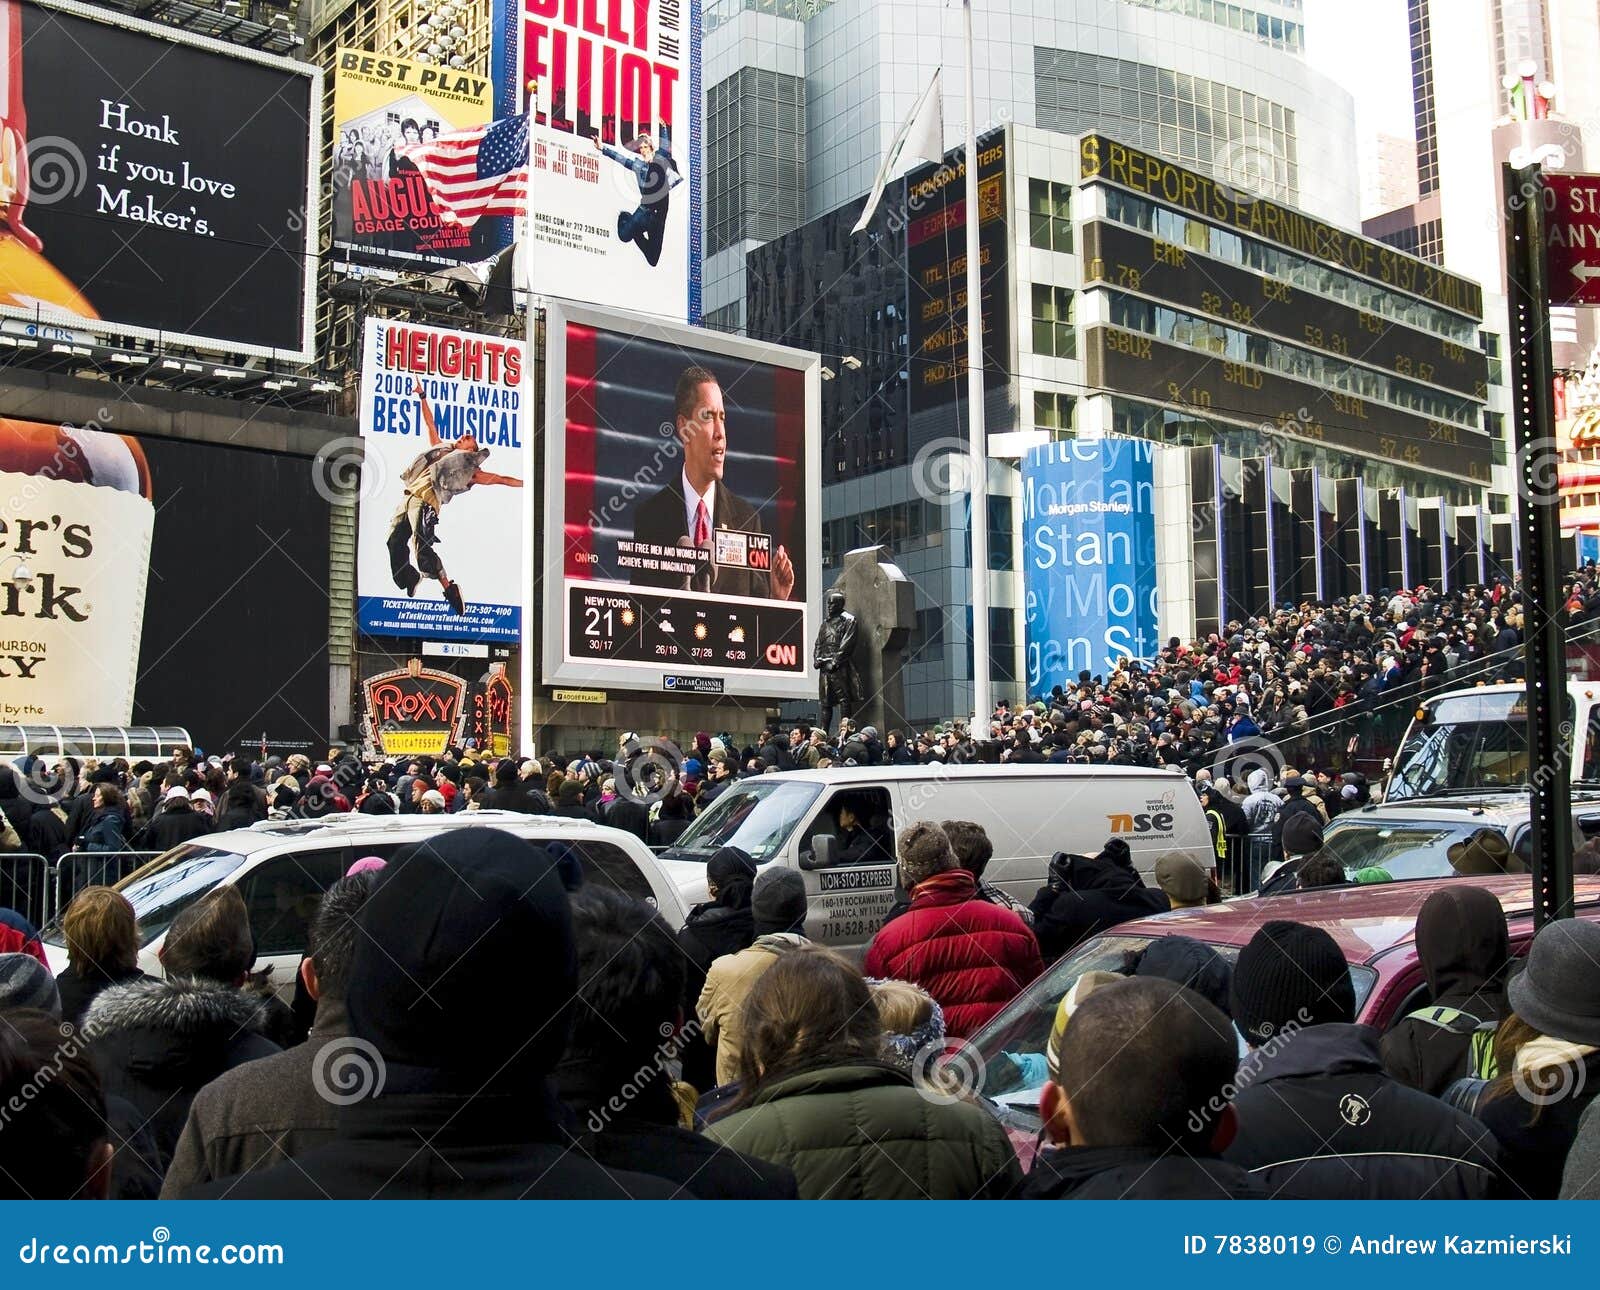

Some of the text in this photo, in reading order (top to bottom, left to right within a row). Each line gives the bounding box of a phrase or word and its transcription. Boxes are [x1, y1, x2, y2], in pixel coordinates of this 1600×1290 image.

[659, 33, 679, 60] THE
[341, 53, 487, 97] BEST PLAY
[342, 72, 484, 106] 2008 TONY AWARD PULITZER PRIZE
[523, 19, 679, 158] ELLIOT
[100, 100, 179, 145] Honk
[558, 150, 568, 163] LEE
[572, 153, 599, 171] STEPHEN
[98, 144, 236, 199] if you love
[552, 161, 568, 176] HALL
[352, 175, 441, 221] AUGU
[1570, 187, 1600, 213] ST
[97, 184, 215, 236] Maker's.
[1109, 142, 1229, 222] REPORTS
[1234, 191, 1345, 268] EARNINGS
[1350, 238, 1375, 275] OF
[355, 220, 405, 234] OSAGE
[923, 207, 959, 237] FOREX
[375, 325, 385, 367] IN THE
[386, 327, 521, 387] HEIGHTS
[375, 373, 520, 410] 2008 TONY AWARD
[374, 396, 521, 448] BEST MUSICAL
[1049, 501, 1132, 516] Morgan Stanley
[618, 541, 709, 561] WHAT FREE MEN AND WOMEN CAN
[749, 536, 769, 550] LIVE
[618, 556, 696, 575] ACHIEVE WHEN IMAGINATION
[749, 550, 769, 568] CNN
[383, 600, 450, 613] TICKETMASTER.COM
[585, 596, 631, 609] NEW YORK
[585, 607, 613, 637] 21
[0, 641, 46, 653] URBON
[589, 640, 613, 651] 30/17
[655, 645, 746, 661] 26/19 37/28 45/28
[766, 643, 797, 666] CNN
[5, 703, 44, 716] by the
[375, 684, 454, 721] ROXY
[387, 737, 443, 748] DELICATESSEN
[1106, 813, 1174, 833] nse
[821, 871, 892, 889] NON-STOP EXPRESS
[822, 897, 843, 908] 160-19
[845, 895, 878, 906] ROCKAWAY
[860, 907, 869, 916] NY
[822, 919, 880, 938] 718-528-83
